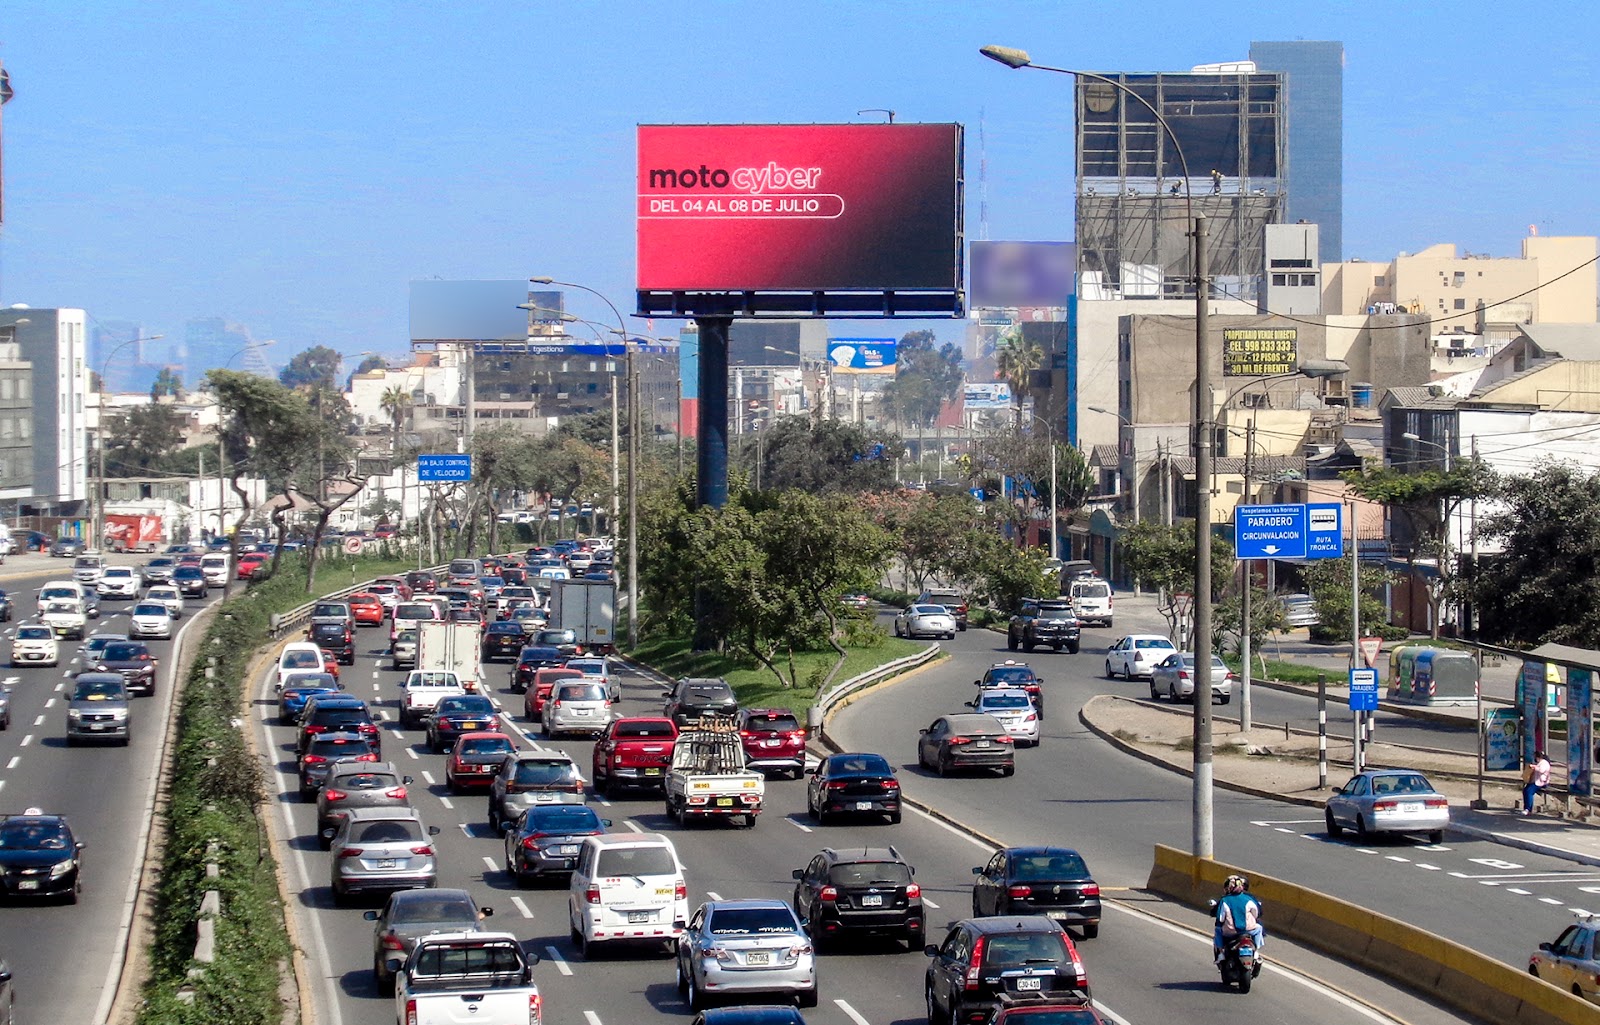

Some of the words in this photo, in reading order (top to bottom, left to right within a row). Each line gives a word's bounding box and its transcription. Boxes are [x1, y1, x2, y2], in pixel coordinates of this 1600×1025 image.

[650, 199, 679, 213] DEL
[682, 199, 702, 213] 04
[706, 199, 726, 213] AL
[729, 199, 749, 213] 08
[752, 199, 772, 213] DE
[775, 199, 819, 213] JULIO
[1225, 330, 1258, 340] PROPIETARIO
[1258, 330, 1275, 340] VENDE
[1275, 330, 1296, 340] DIRECTO
[1245, 341, 1260, 352] 998
[1261, 341, 1276, 352] 333
[1276, 341, 1291, 352] 333
[1252, 353, 1260, 362] 12
[1261, 352, 1281, 362] PISOS
[1231, 364, 1242, 374] 30
[1254, 364, 1263, 373] DE
[1264, 364, 1290, 373] FRENTE
[422, 469, 430, 477] DE
[434, 469, 466, 477] VELOCIDAD
[1248, 516, 1293, 527] PARADERO
[1242, 531, 1299, 540] CIRCUNVALACION
